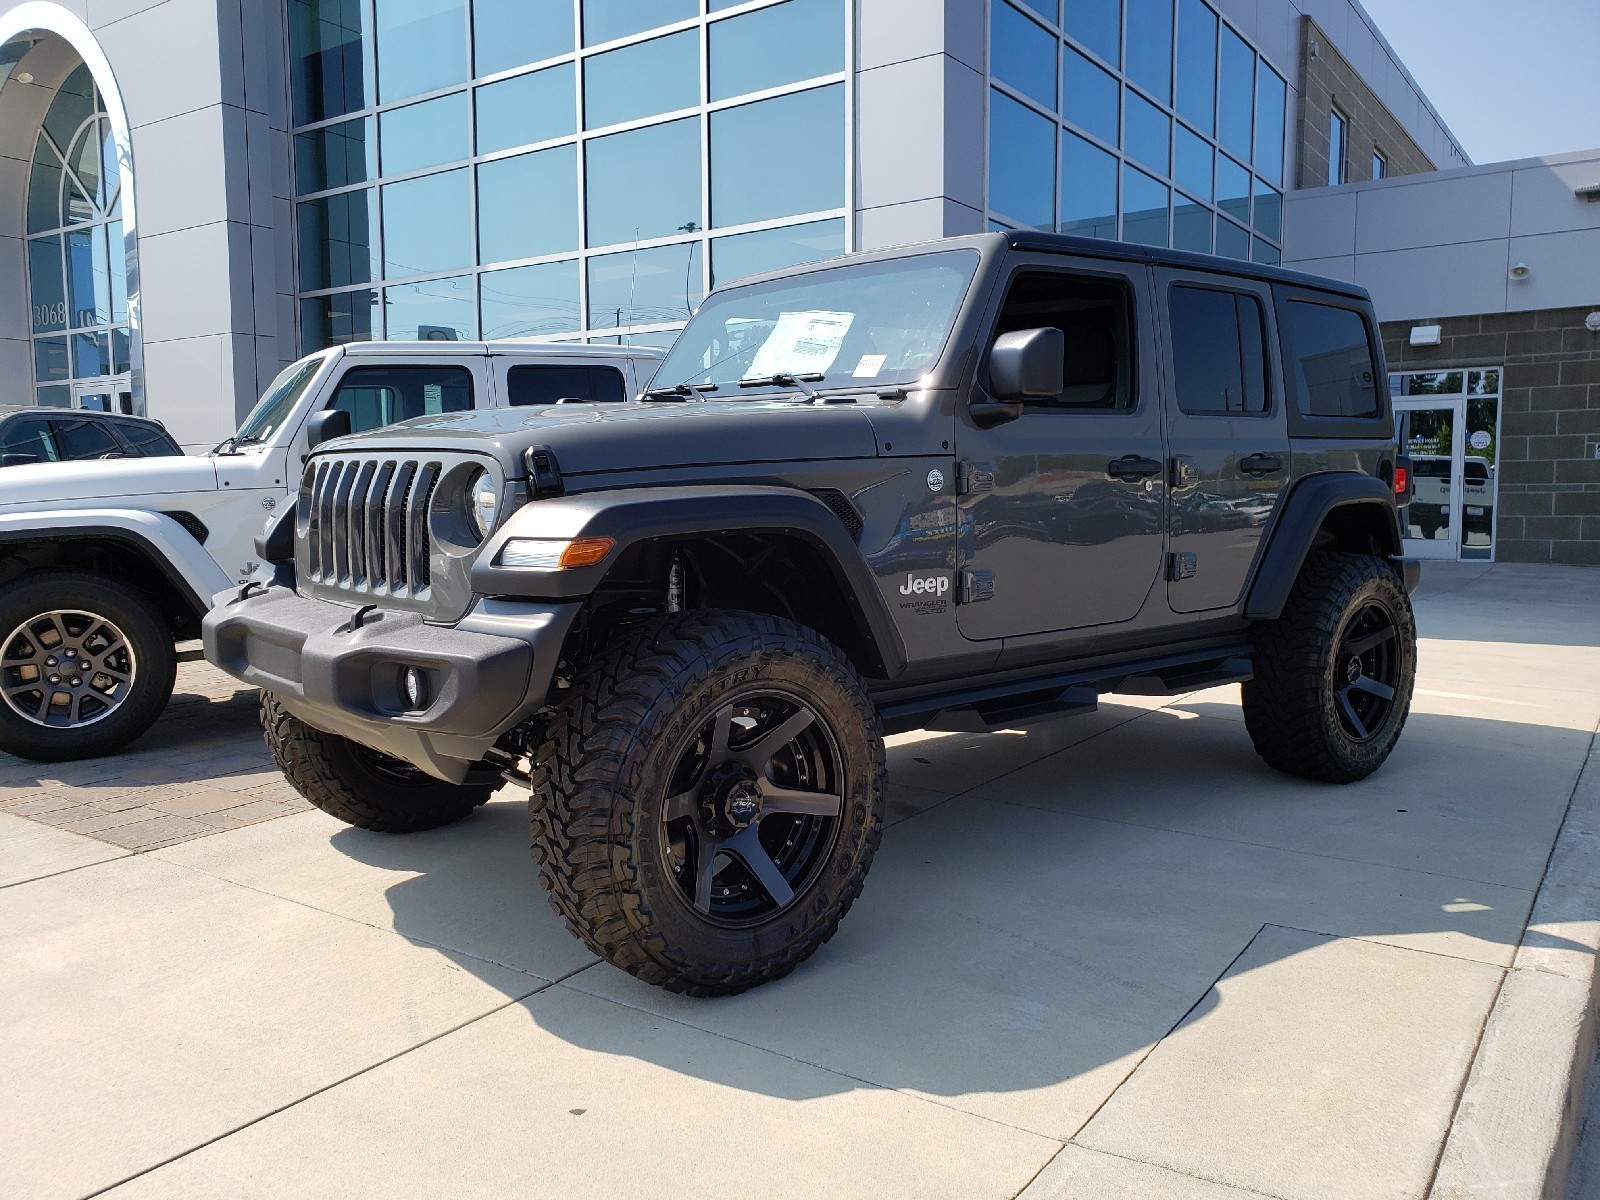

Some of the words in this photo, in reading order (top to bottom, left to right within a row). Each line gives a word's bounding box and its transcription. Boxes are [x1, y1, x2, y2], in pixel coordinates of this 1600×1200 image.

[33, 302, 66, 327] 3068
[899, 573, 949, 596] Jeep
[900, 599, 947, 609] WRANGLER
[653, 663, 770, 770] COUNTRY
